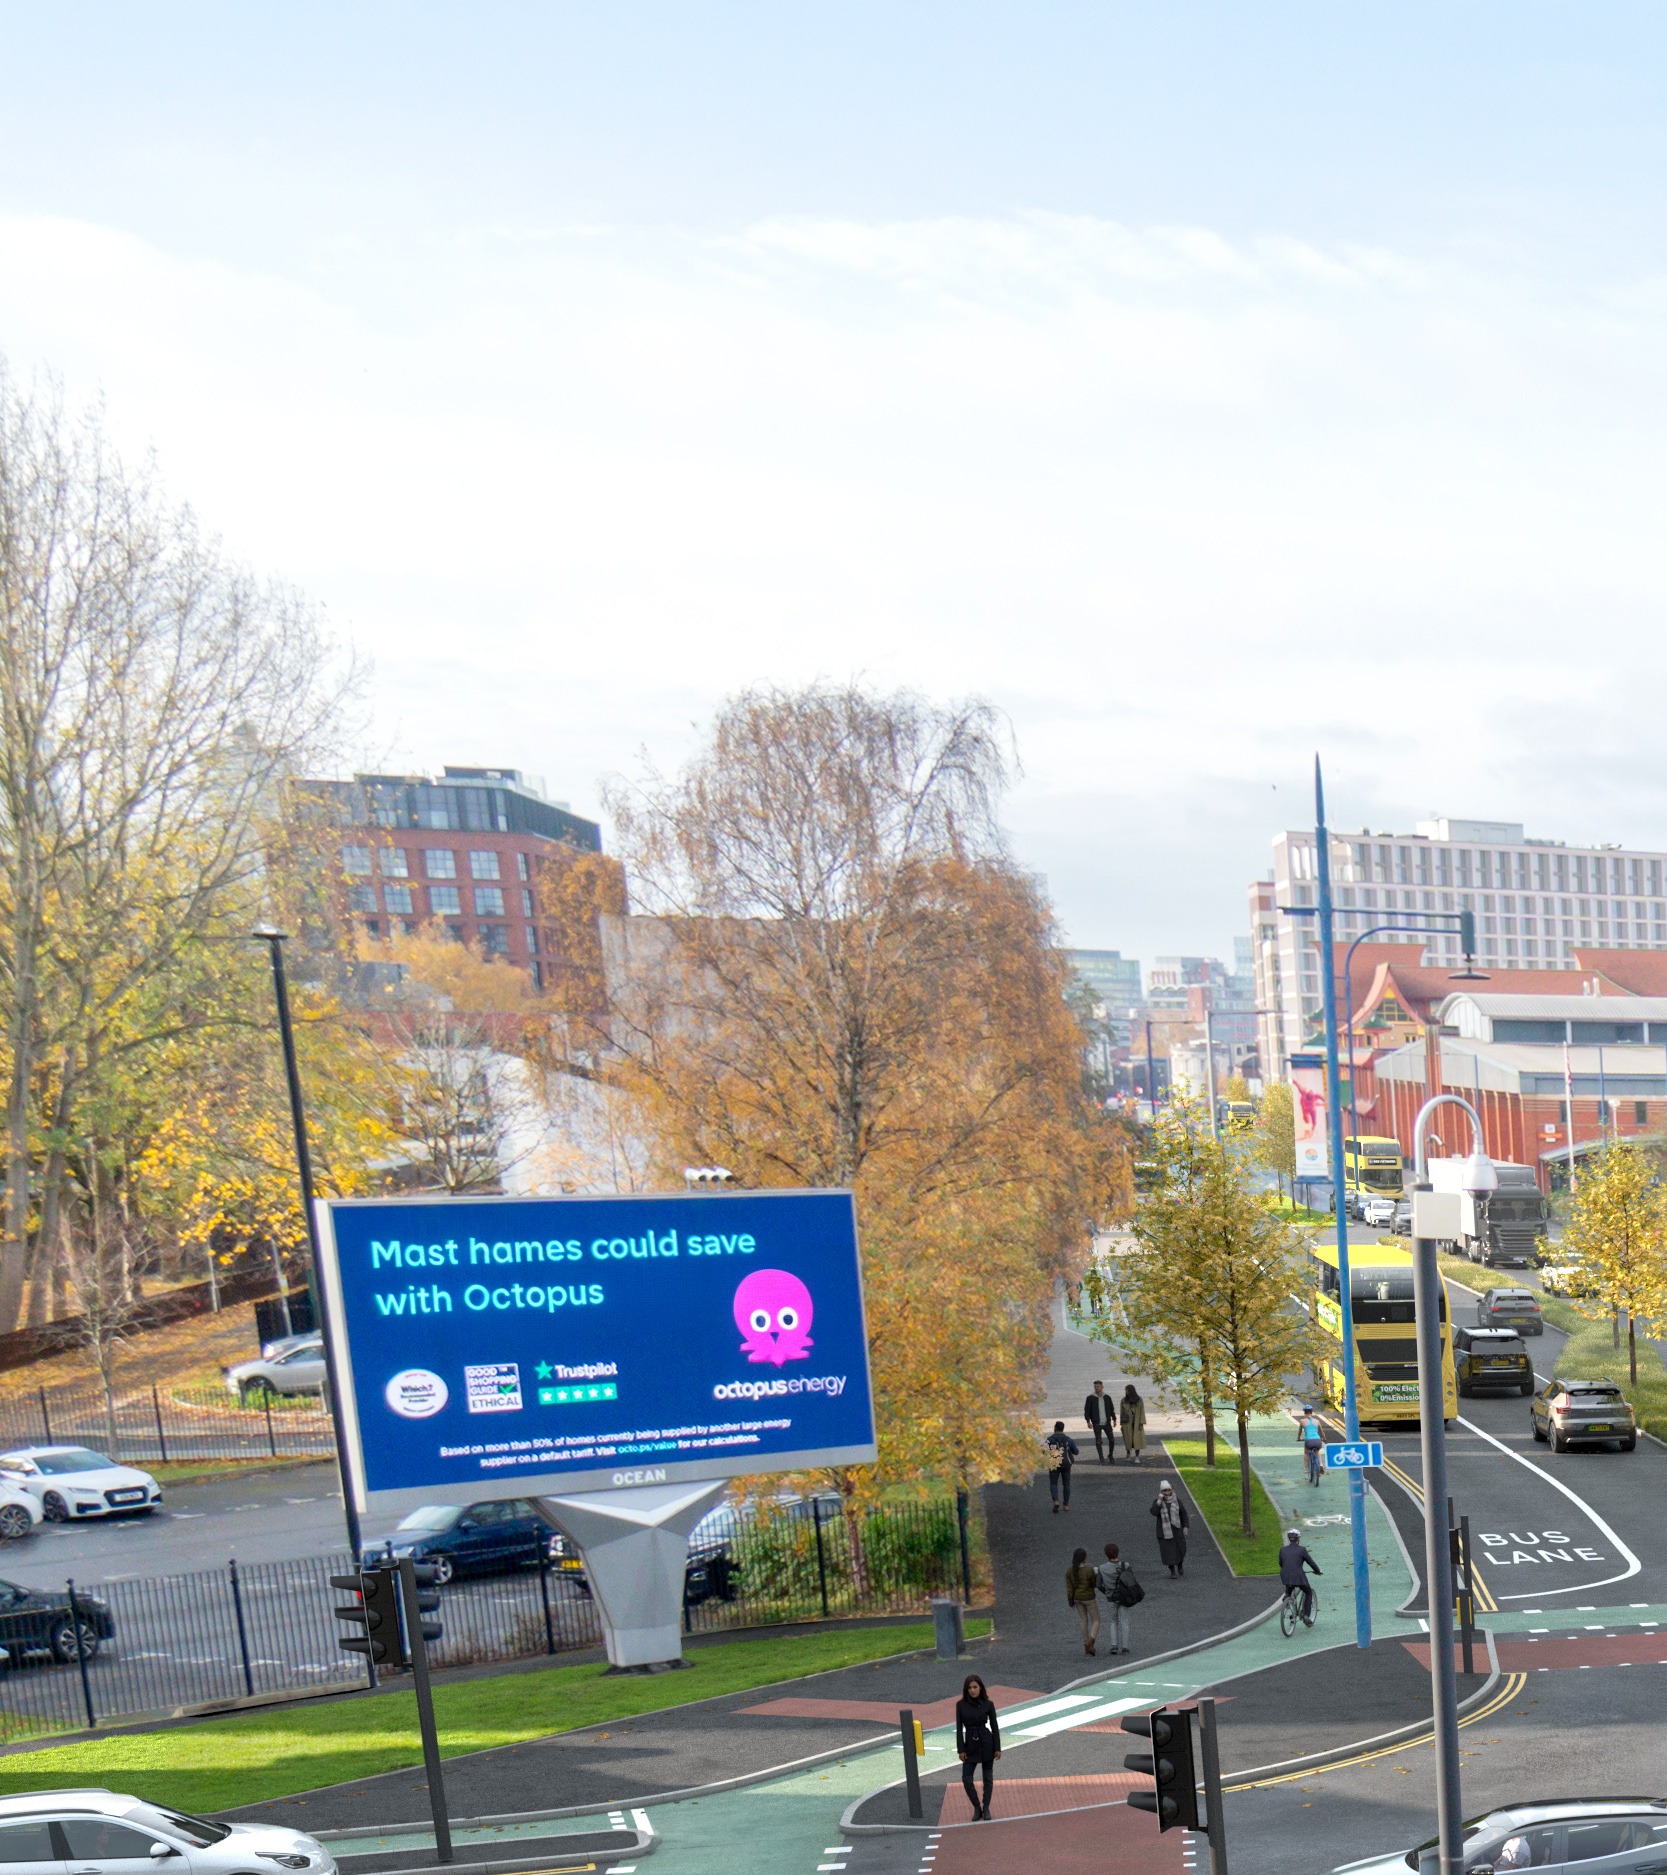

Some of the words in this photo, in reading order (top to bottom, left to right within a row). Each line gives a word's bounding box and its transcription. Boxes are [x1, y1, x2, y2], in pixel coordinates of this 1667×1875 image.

[591, 1228, 679, 1260] could
[687, 1233, 756, 1256] save
[375, 1284, 453, 1315] with
[464, 1282, 605, 1313] Octopus
[468, 1367, 498, 1377] GOOD
[554, 1361, 618, 1379] Trustpilot
[469, 1374, 518, 1386] SHOPPING
[470, 1384, 499, 1395] GUIDE
[472, 1396, 520, 1409] ETHICAL
[440, 1446, 469, 1457] Based
[471, 1445, 483, 1454] on
[485, 1443, 510, 1453] more
[510, 1439, 532, 1450] than
[555, 1436, 565, 1446] of
[565, 1434, 595, 1446] homes
[697, 1425, 708, 1435] by
[480, 1456, 517, 1468] supplier
[518, 1454, 530, 1463] on
[539, 1449, 571, 1461] default
[678, 1439, 691, 1449] for
[692, 1438, 708, 1448] our
[613, 1469, 667, 1486] OCEAN
[1478, 1531, 1570, 1546] BUS
[1483, 1548, 1605, 1565] LANE
